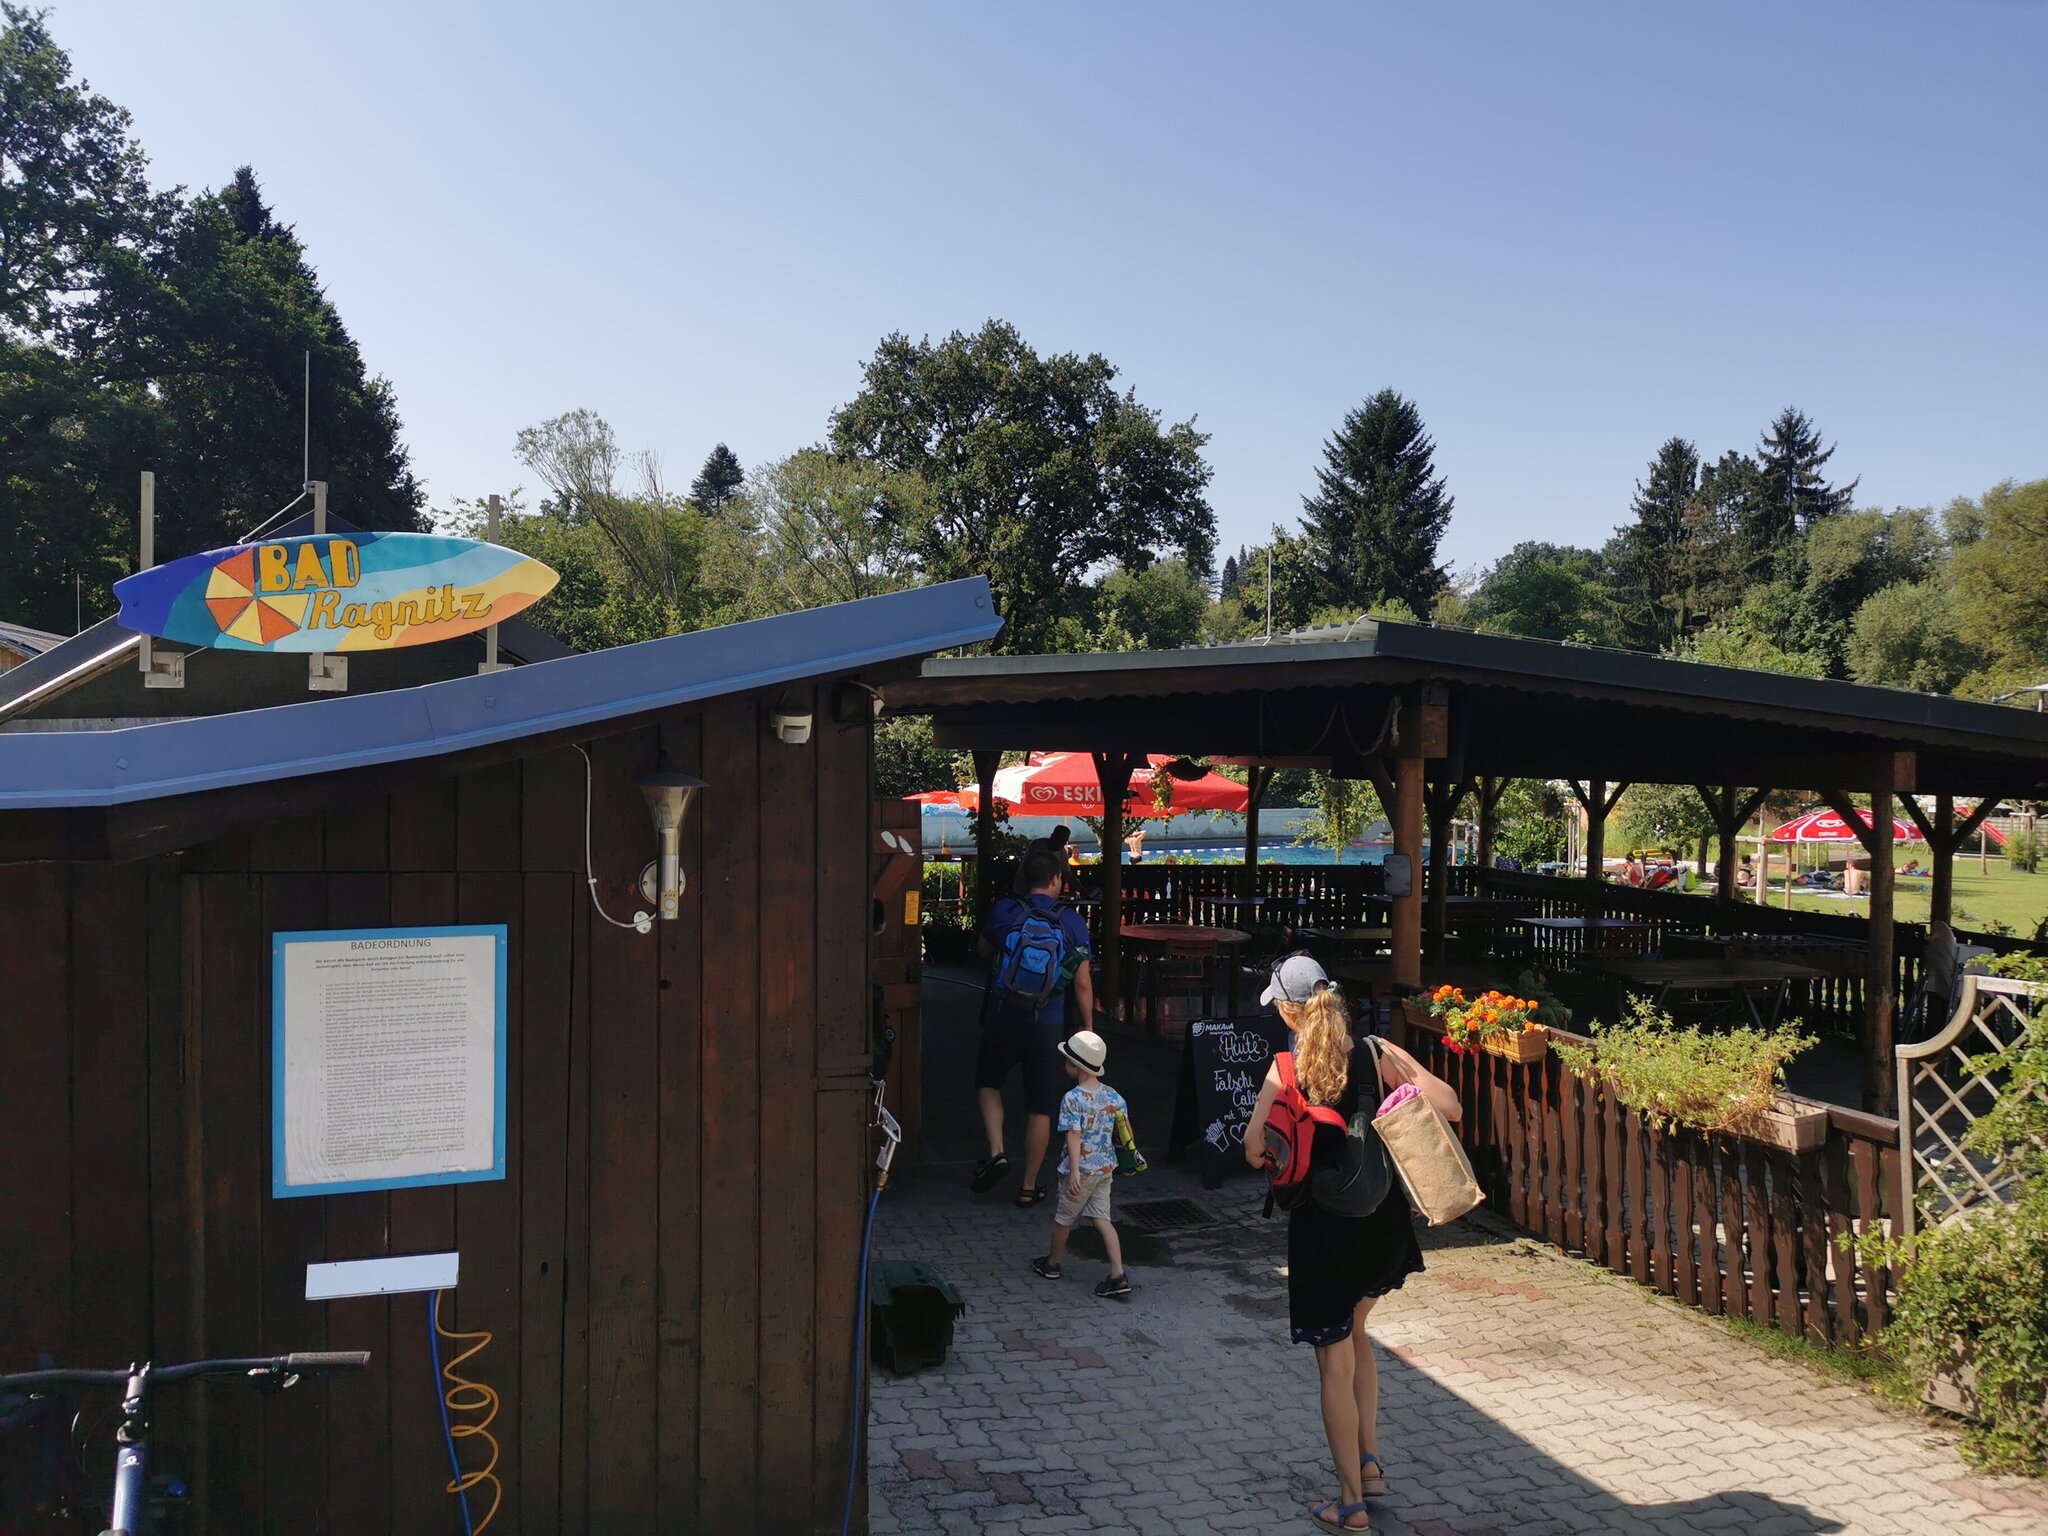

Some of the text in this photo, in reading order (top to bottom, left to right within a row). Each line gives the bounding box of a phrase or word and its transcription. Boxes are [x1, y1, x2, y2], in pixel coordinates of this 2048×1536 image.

[258, 539, 361, 592] BAD
[308, 583, 492, 640] Ragnitz
[1063, 786, 1103, 802] ESKI
[350, 938, 432, 950] BADEORDNUNG
[1224, 1035, 1260, 1057] Heute
[1224, 1110, 1236, 1120] mit
